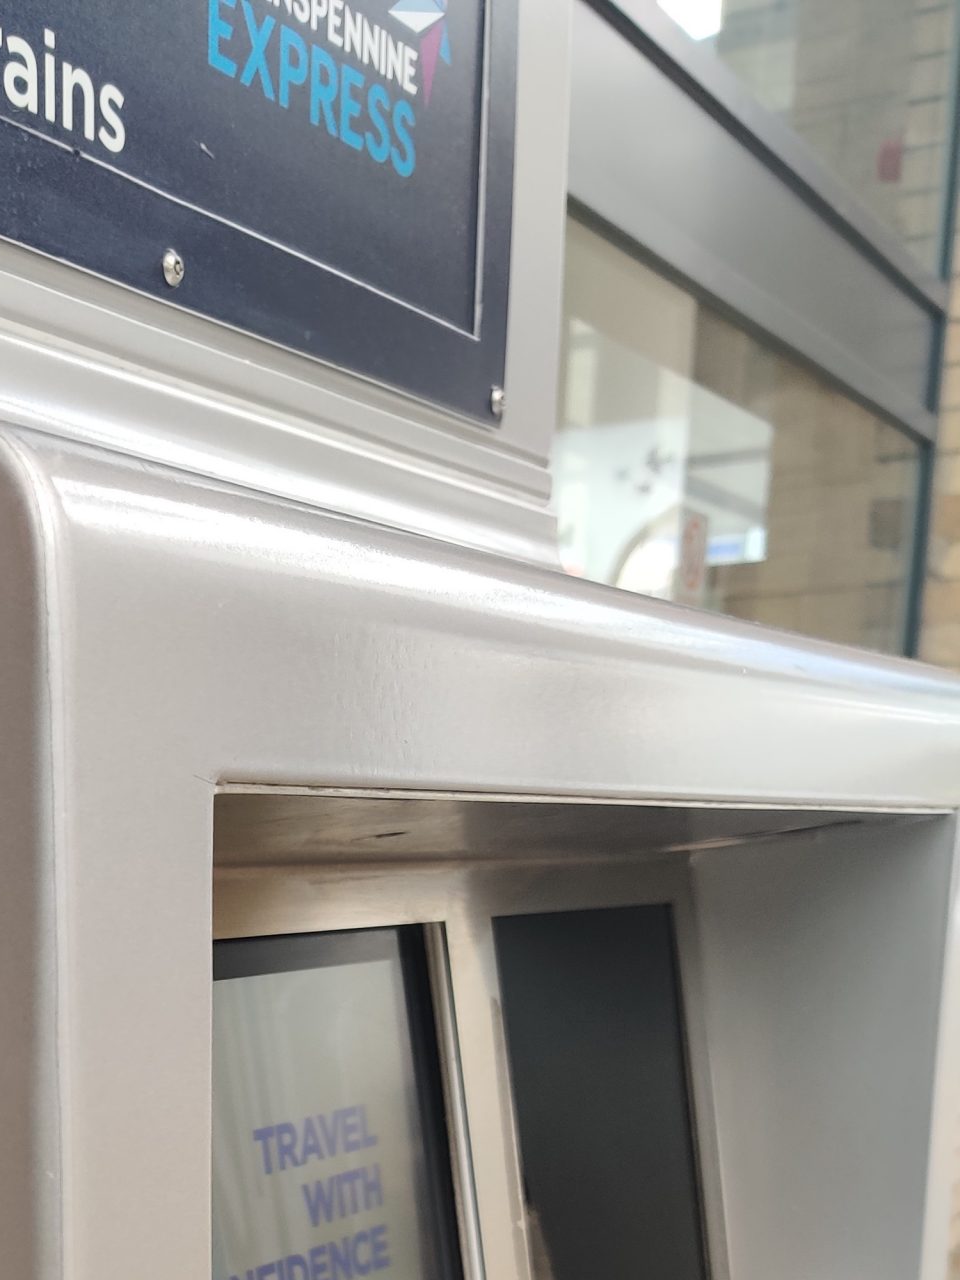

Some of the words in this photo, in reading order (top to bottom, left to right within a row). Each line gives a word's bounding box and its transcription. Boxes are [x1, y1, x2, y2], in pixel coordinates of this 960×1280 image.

[207, 0, 417, 178] EXPRESS
[252, 1103, 378, 1175] TRAVEL
[302, 1162, 384, 1228] WITH
